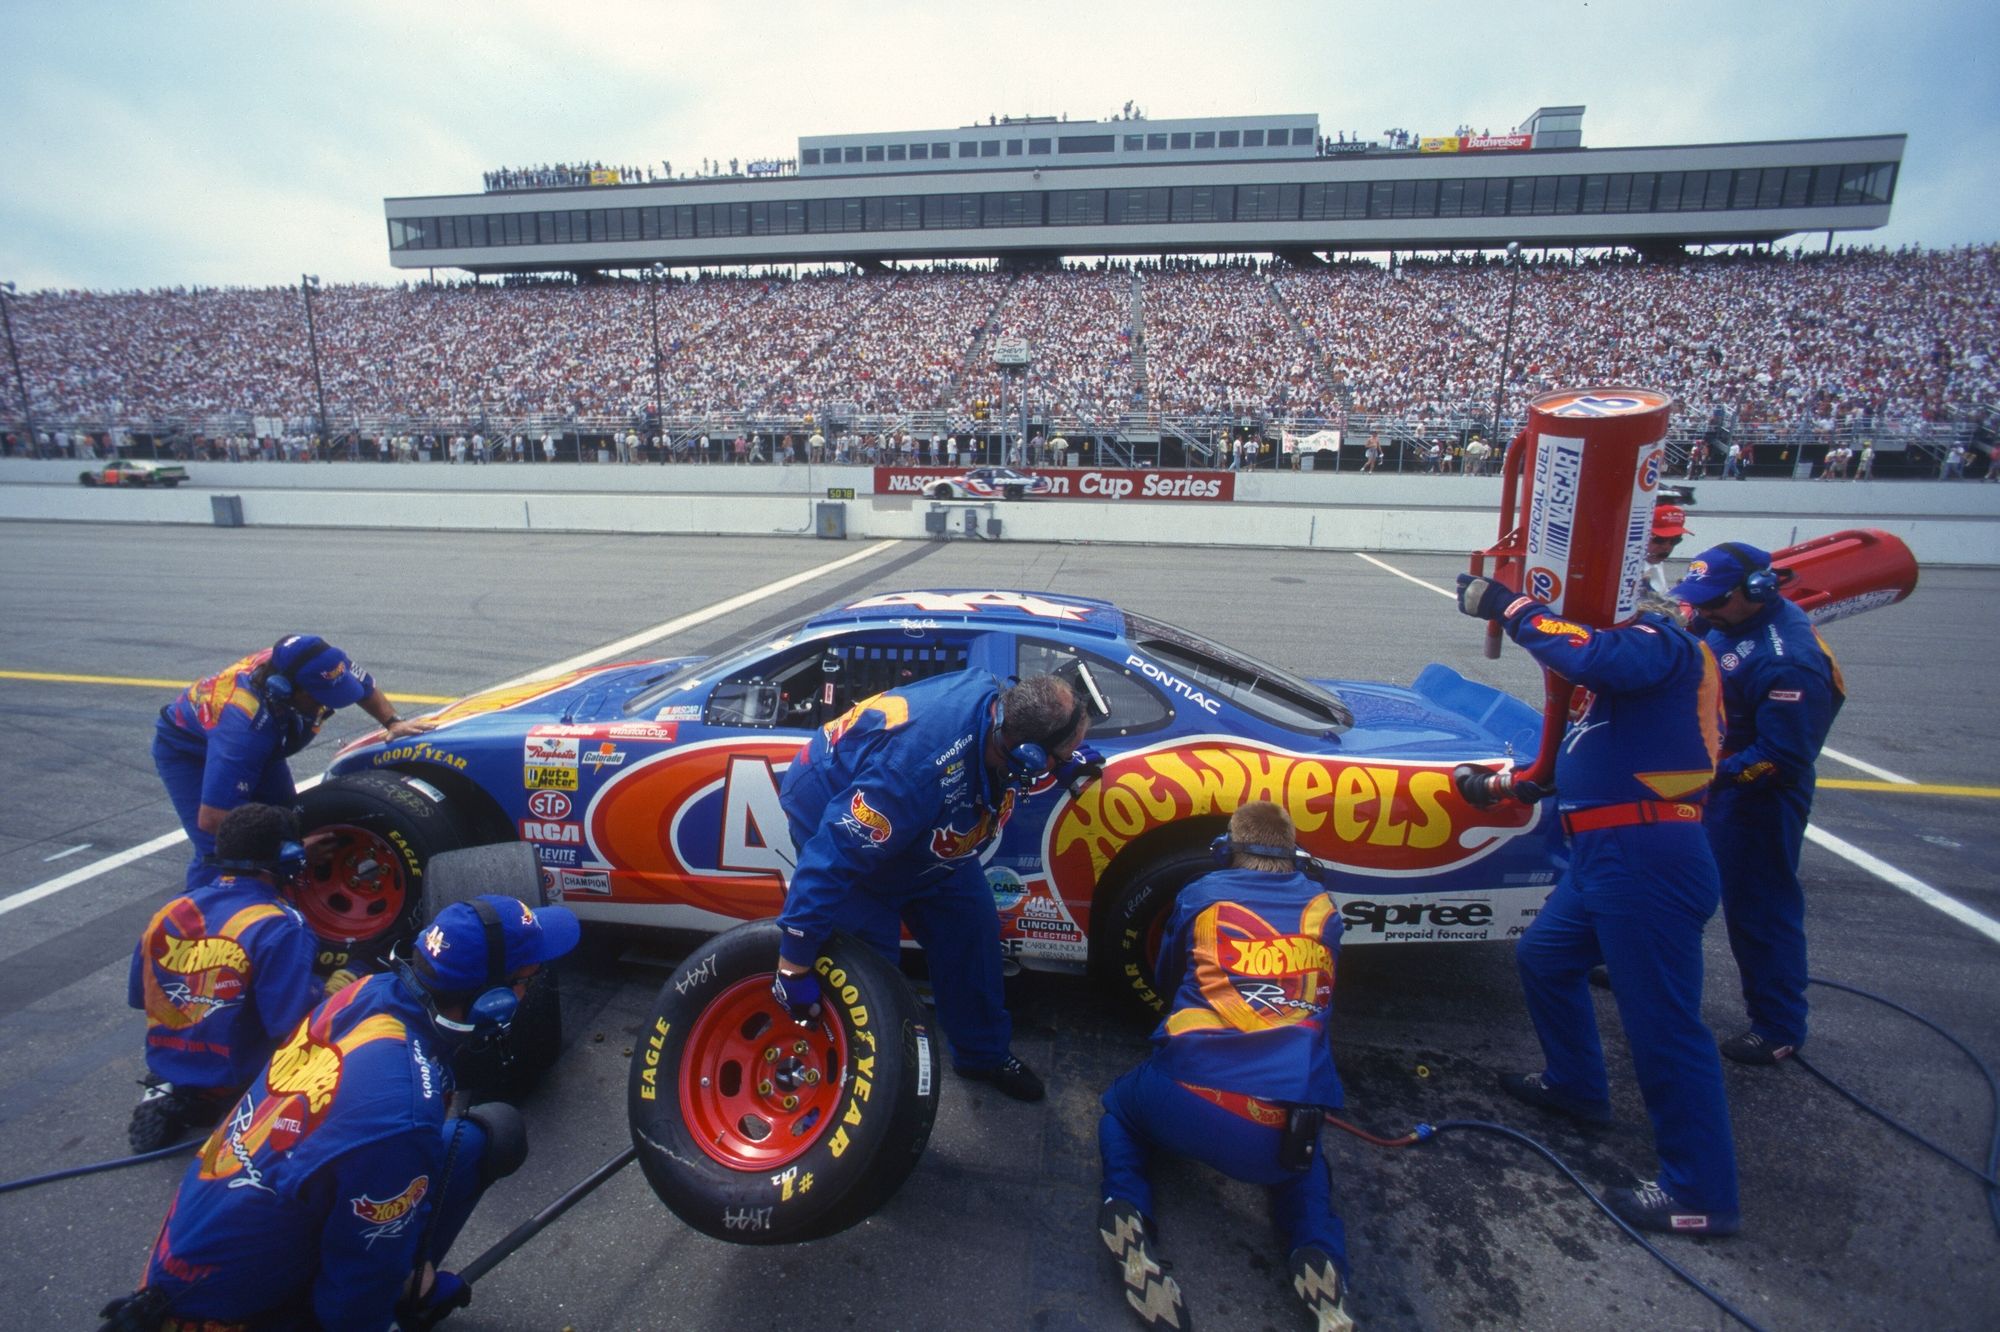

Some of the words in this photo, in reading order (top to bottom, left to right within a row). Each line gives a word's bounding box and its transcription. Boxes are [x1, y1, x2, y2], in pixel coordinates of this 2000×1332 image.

[1328, 143, 1366, 153] KENWOOD
[1468, 136, 1526, 149] Budweiser
[998, 347, 1025, 355] CHEVY
[1536, 444, 1549, 482] FUEL
[1645, 454, 1665, 485] 76
[1079, 473, 1133, 499] Cup
[1142, 474, 1221, 498] Series
[1549, 445, 1580, 527] NASCAR
[1529, 485, 1545, 554] OFFICIAL
[1531, 572, 1551, 602] 76
[1125, 654, 1222, 716] PONTIAC
[608, 727, 646, 737] Winston
[647, 728, 668, 738] Cup
[373, 742, 467, 770] GOODYEAR
[526, 745, 577, 762] Raybestos
[584, 752, 621, 763] Gatorade
[935, 734, 973, 766] GOODYEAR
[538, 776, 576, 788] Meter
[541, 768, 570, 778] Auto
[534, 793, 566, 814] STP
[524, 822, 580, 842] RCA
[389, 830, 422, 877] EAGLE
[534, 845, 577, 862] LEVITE
[564, 877, 608, 889] CHAMPION
[1023, 896, 1058, 913] MAC
[1024, 911, 1058, 919] TOOLS
[1341, 900, 1493, 933] spree
[1021, 920, 1071, 932] LINCOLN
[1032, 931, 1077, 941] ELECTRIC
[1385, 929, 1433, 942] prepaid
[1024, 941, 1087, 953] CARBORUNDUM
[1230, 939, 1285, 976] Hot
[214, 980, 241, 990] MATTEL
[161, 982, 242, 1019] Racing
[641, 1015, 671, 1101] EAGLE
[814, 955, 878, 1159] GOODYEAR
[413, 1039, 433, 1099] GOODYEAR
[272, 1117, 302, 1134] MATTEL
[227, 1093, 277, 1196] Racing
